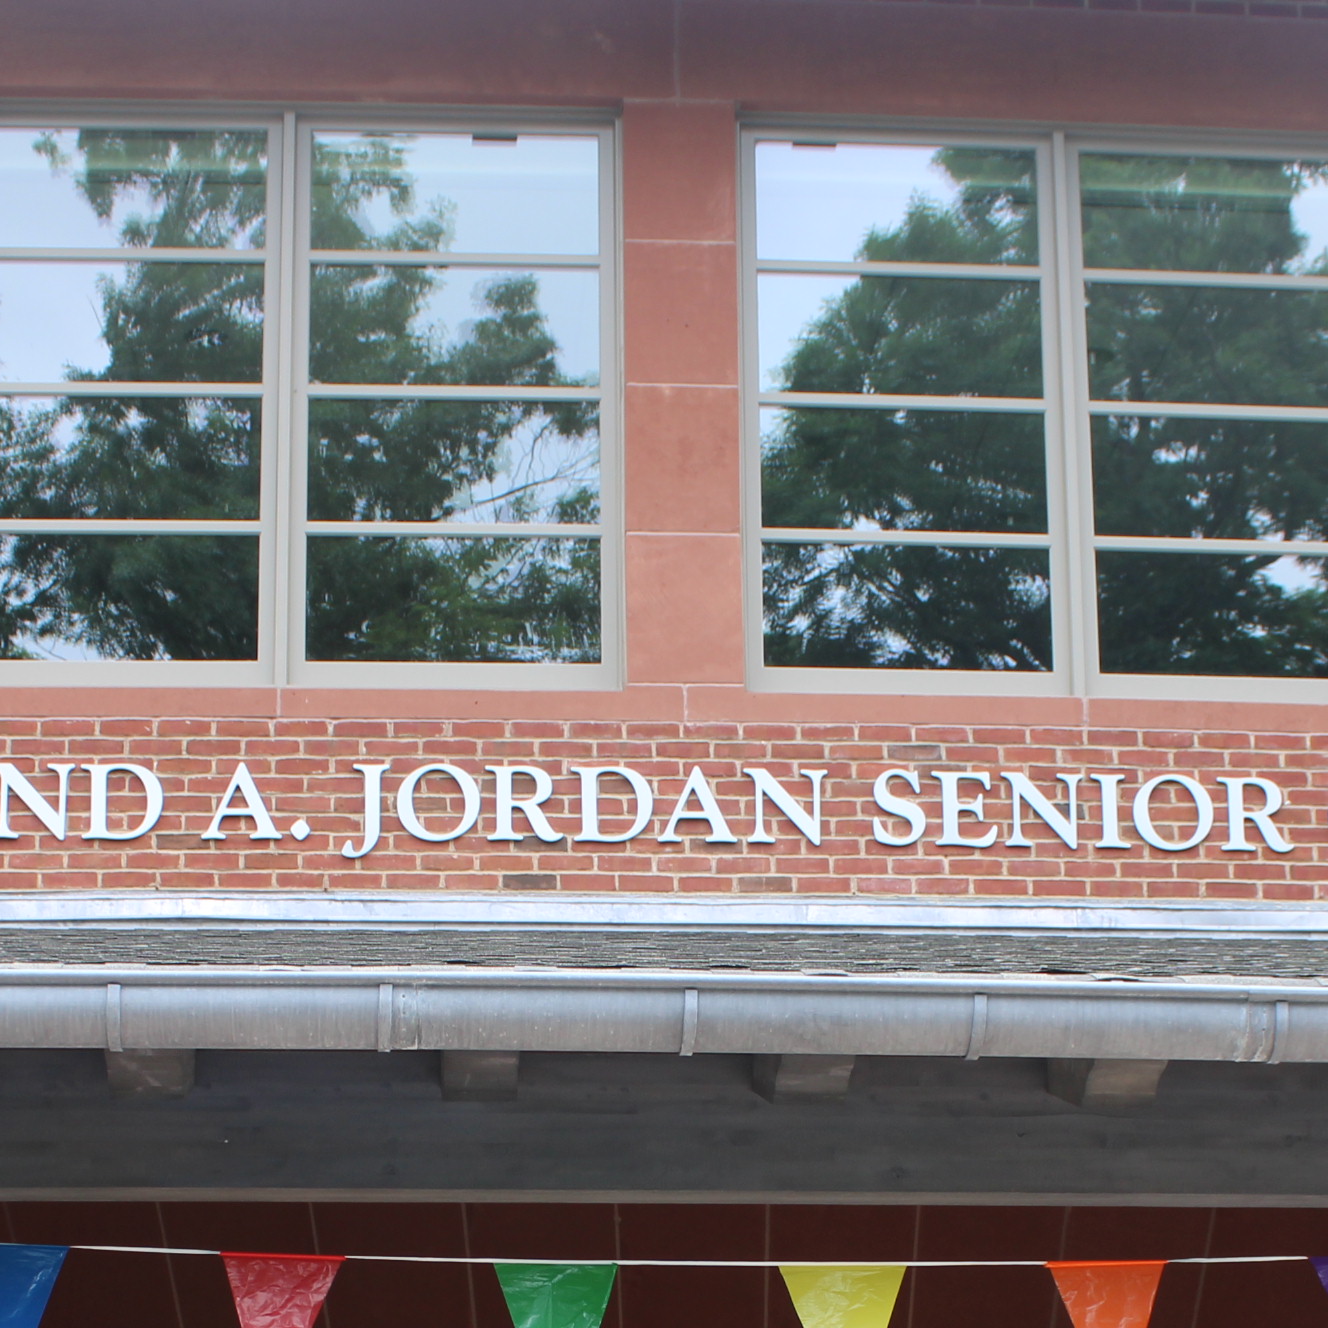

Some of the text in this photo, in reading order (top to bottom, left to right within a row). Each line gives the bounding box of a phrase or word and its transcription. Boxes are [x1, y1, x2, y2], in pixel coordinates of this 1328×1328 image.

[200, 761, 311, 842] A.
[341, 763, 829, 859] JORDAN
[871, 769, 1295, 853] SENIOR
